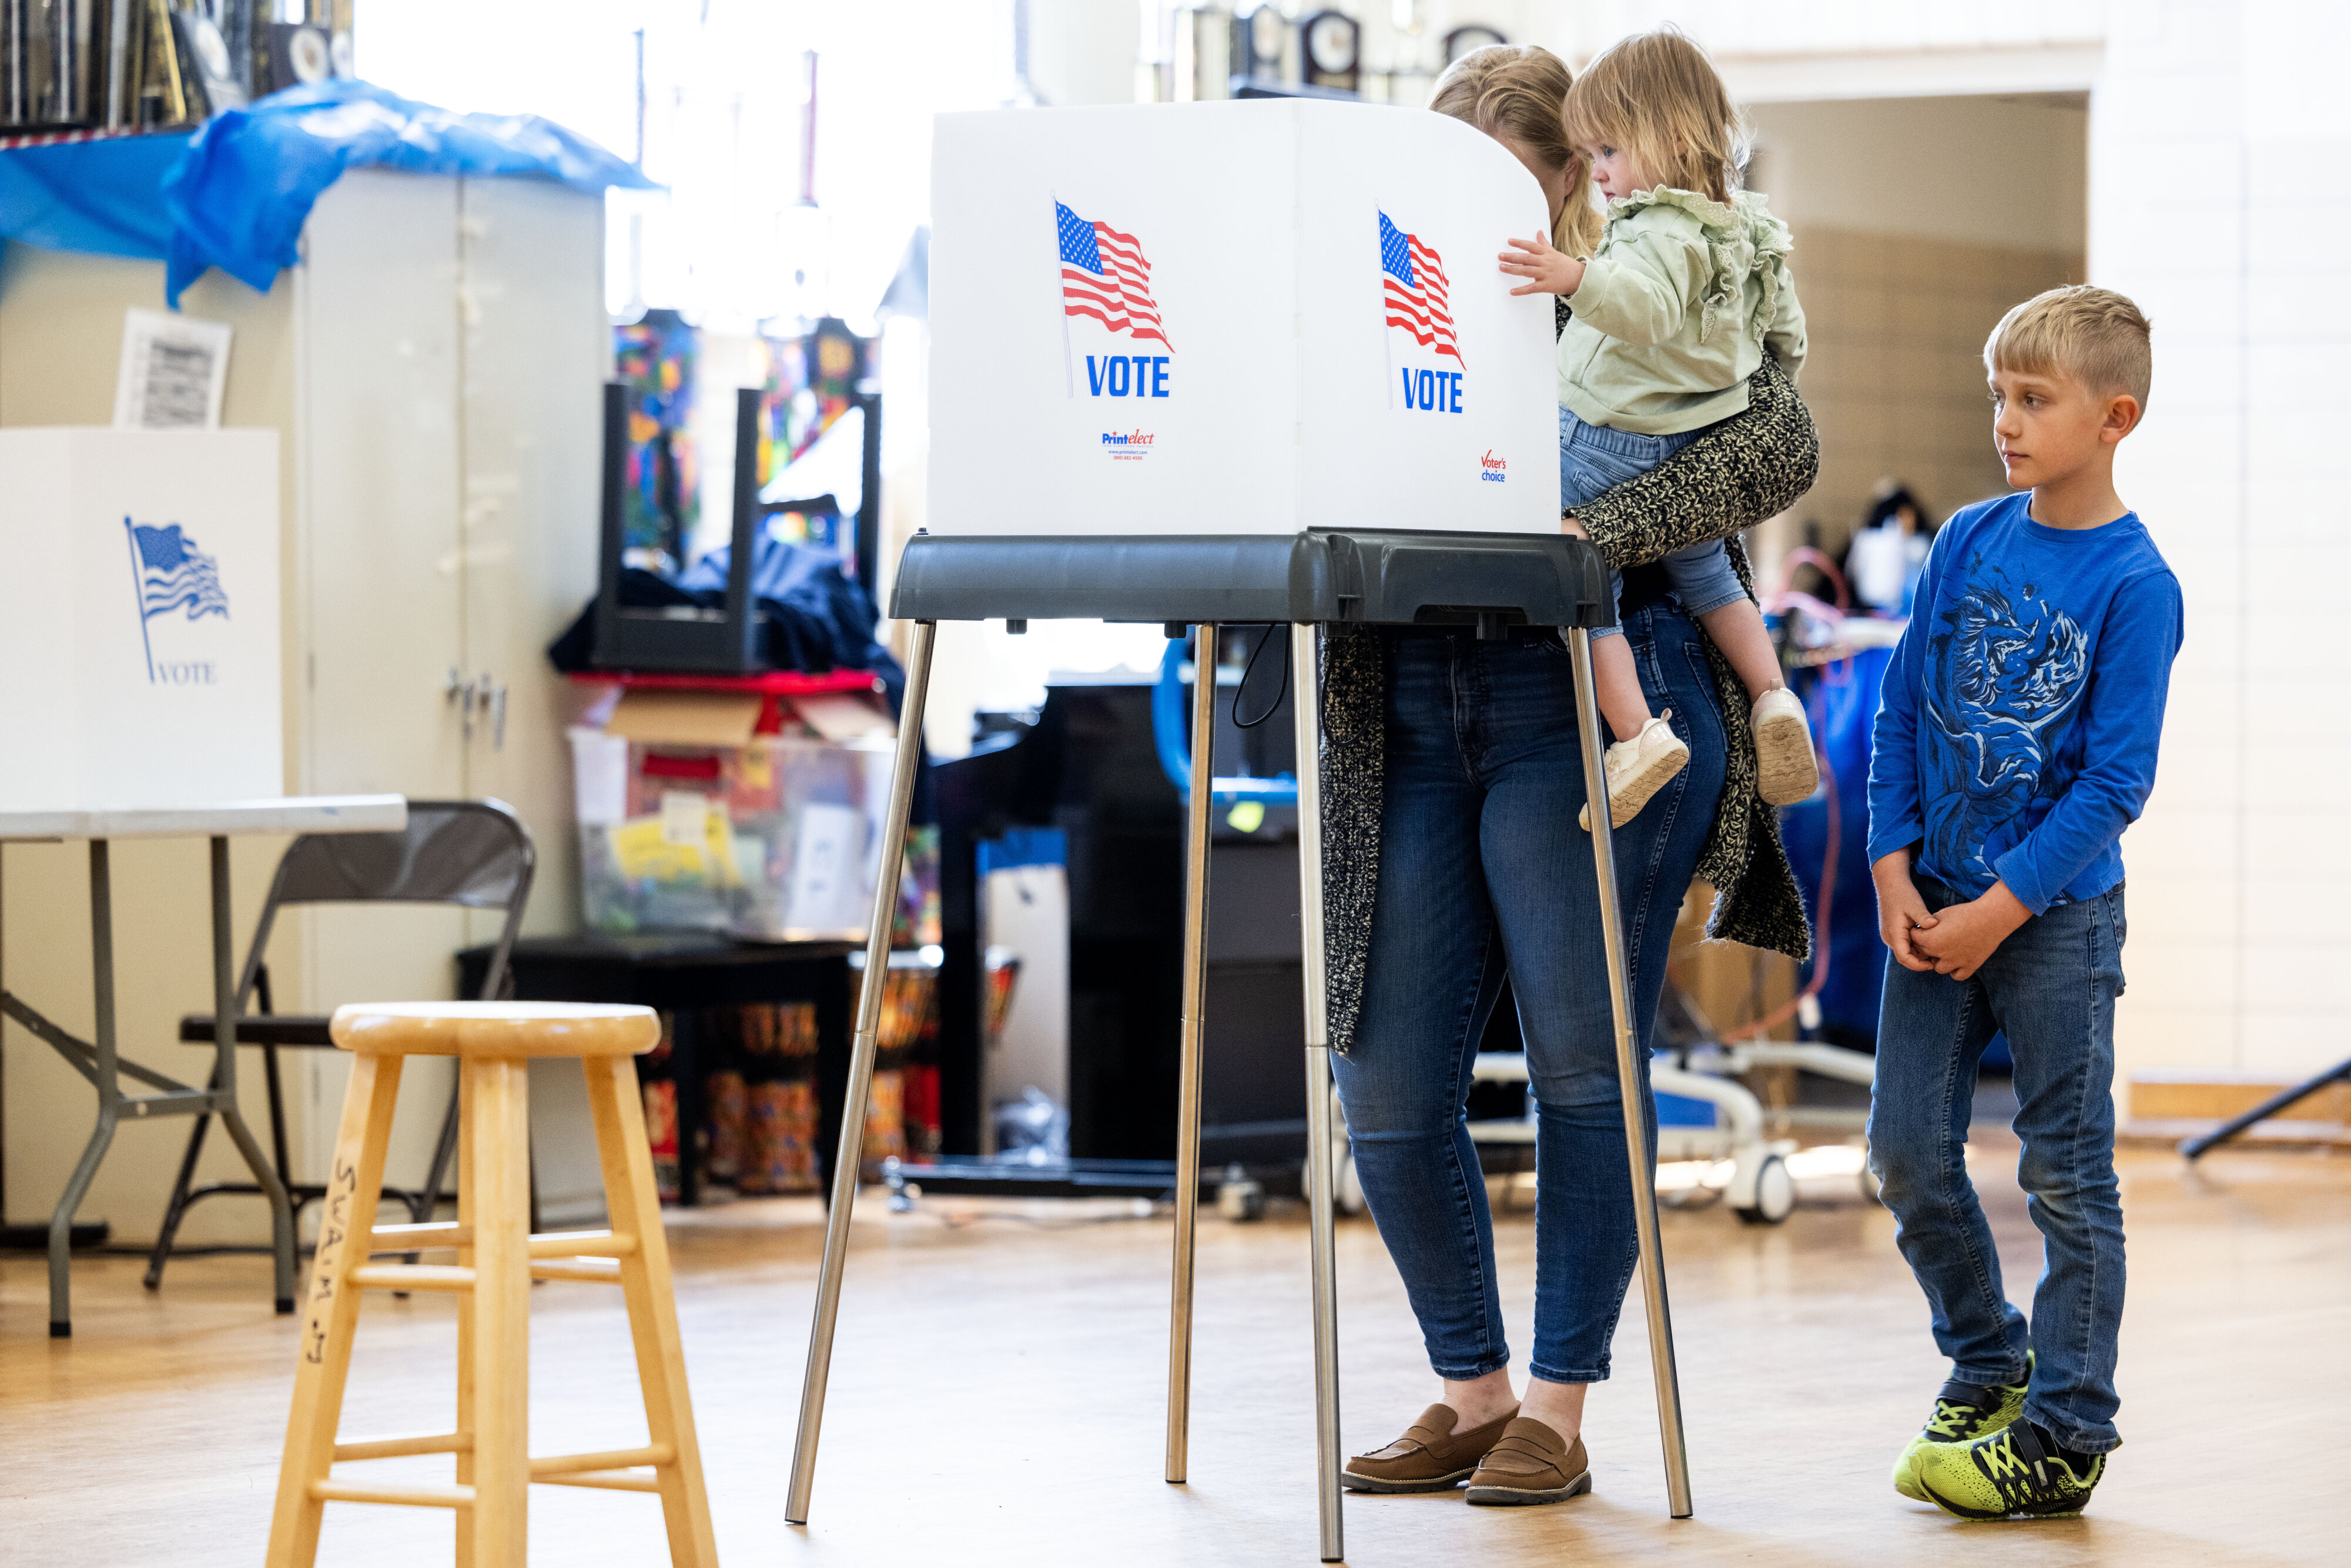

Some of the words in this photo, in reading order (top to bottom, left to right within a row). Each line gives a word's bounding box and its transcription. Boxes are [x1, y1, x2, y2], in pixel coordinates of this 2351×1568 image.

[1086, 356, 1170, 397] VOTE
[1402, 367, 1463, 414] VOTE
[1102, 429, 1155, 444] Printelect
[1481, 449, 1506, 469] Voter's
[1482, 470, 1505, 482] choice
[158, 662, 218, 686] VOTE
